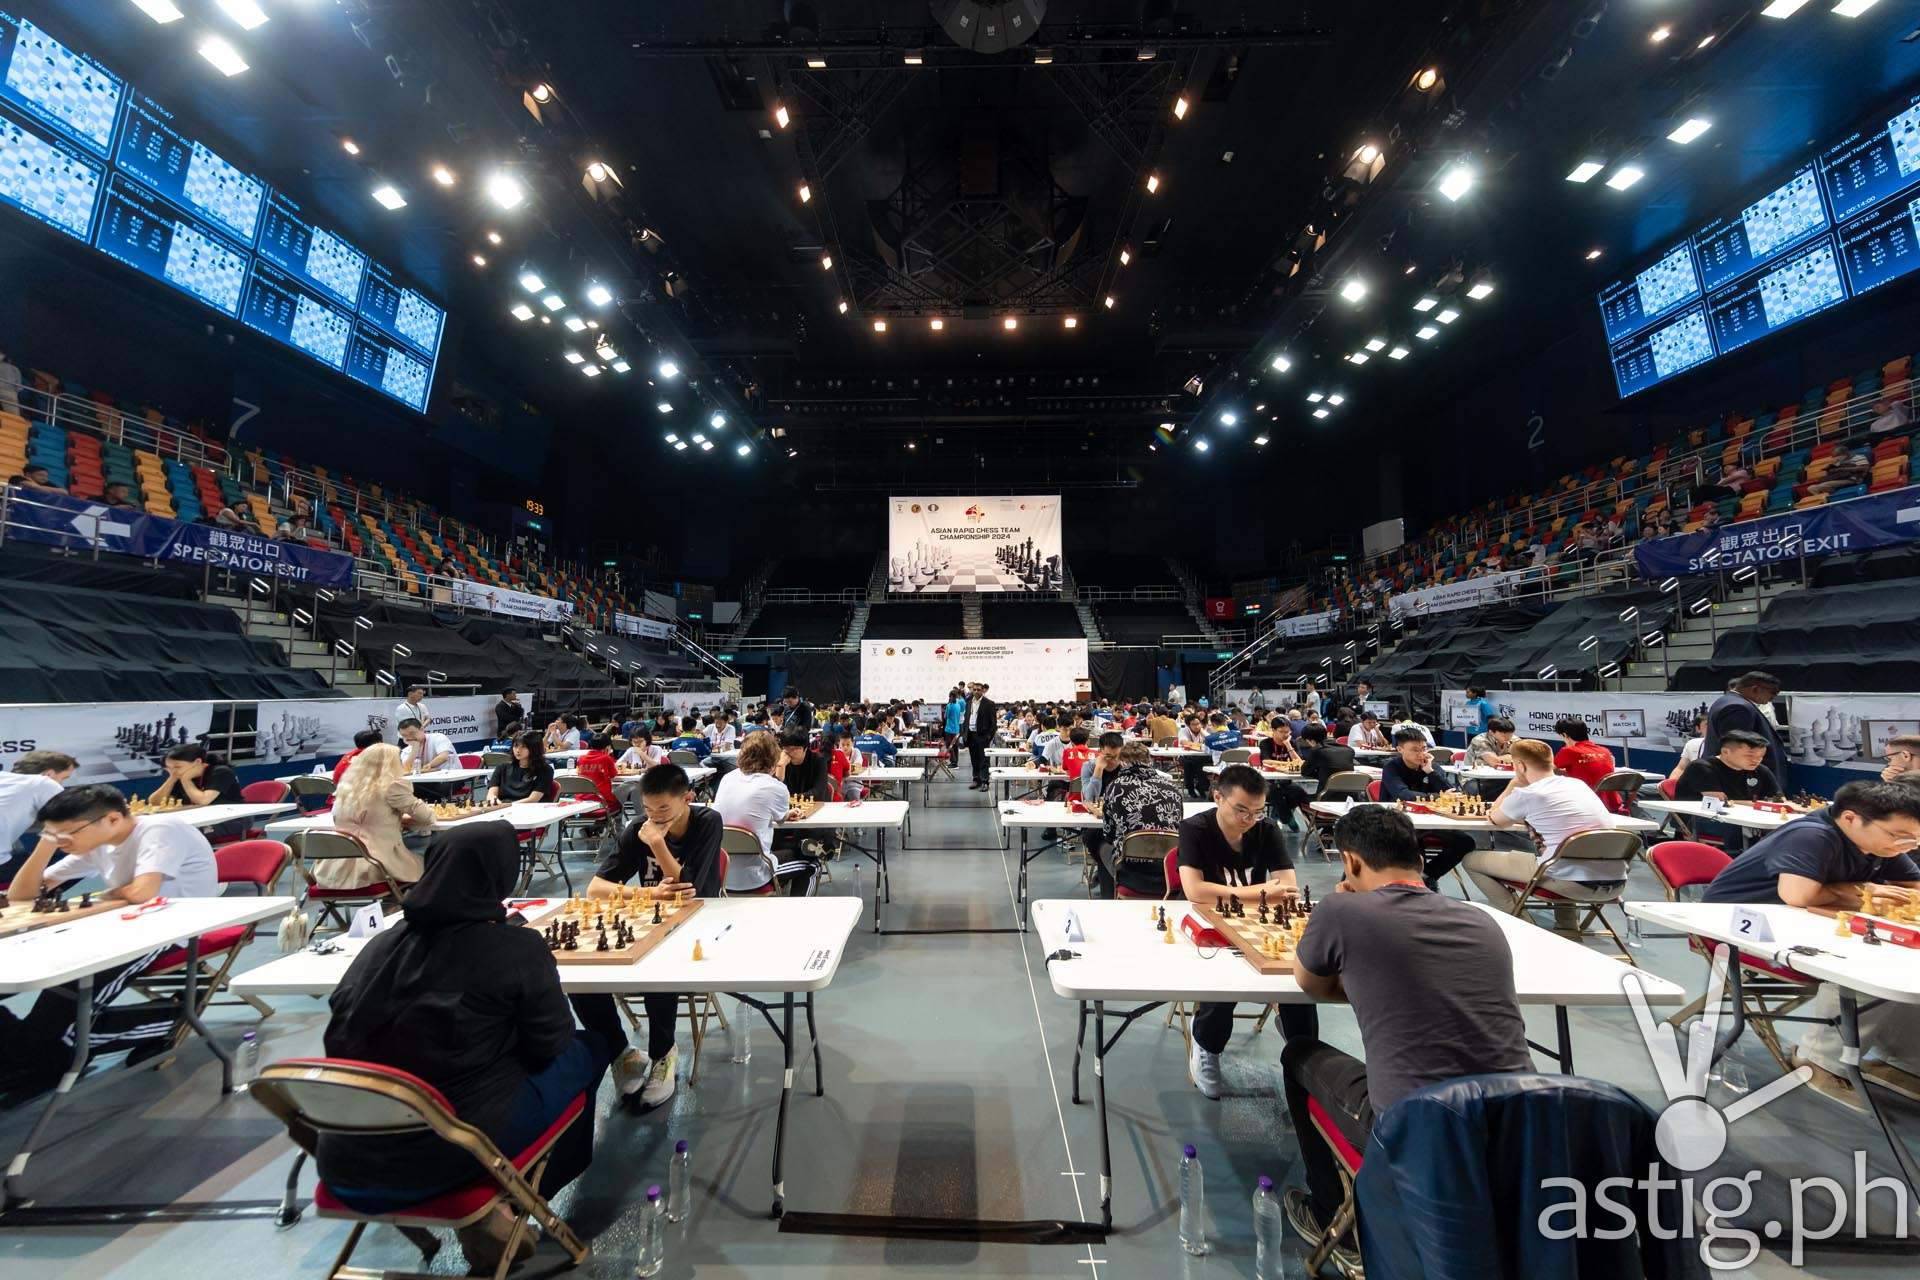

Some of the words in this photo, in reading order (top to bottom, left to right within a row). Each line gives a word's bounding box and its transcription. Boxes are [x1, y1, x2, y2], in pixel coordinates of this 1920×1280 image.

[1832, 151, 1852, 167] Rapid
[1852, 140, 1872, 155] Team
[1850, 230, 1871, 243] Rapid
[1872, 219, 1892, 232] Team
[1527, 416, 1545, 449] 2
[1804, 532, 1851, 553] EXIT
[278, 562, 310, 579] EXIT
[453, 715, 476, 723] CHINA
[1529, 711, 1554, 720] HONG
[0, 740, 36, 753] SS
[369, 915, 376, 929] 4
[1740, 914, 1752, 934] 2
